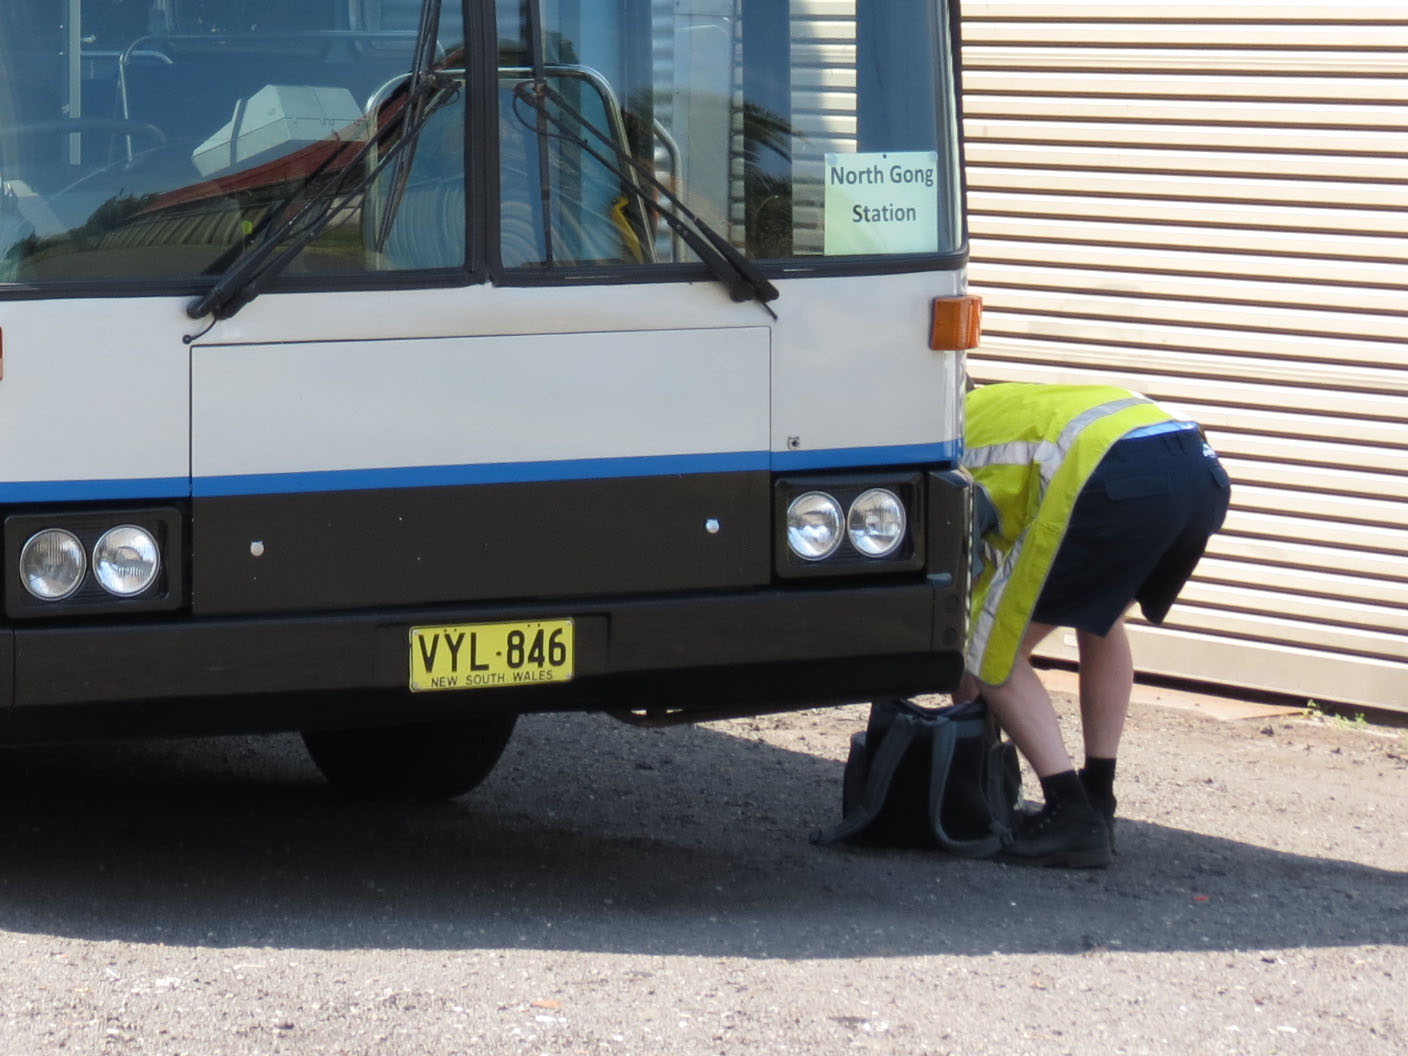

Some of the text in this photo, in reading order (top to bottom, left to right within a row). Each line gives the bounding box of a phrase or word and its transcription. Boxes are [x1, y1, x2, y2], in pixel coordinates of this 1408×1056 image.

[831, 164, 934, 187] North Gong
[852, 203, 916, 223] Station
[431, 670, 553, 688] NEW SOUTH WALES
